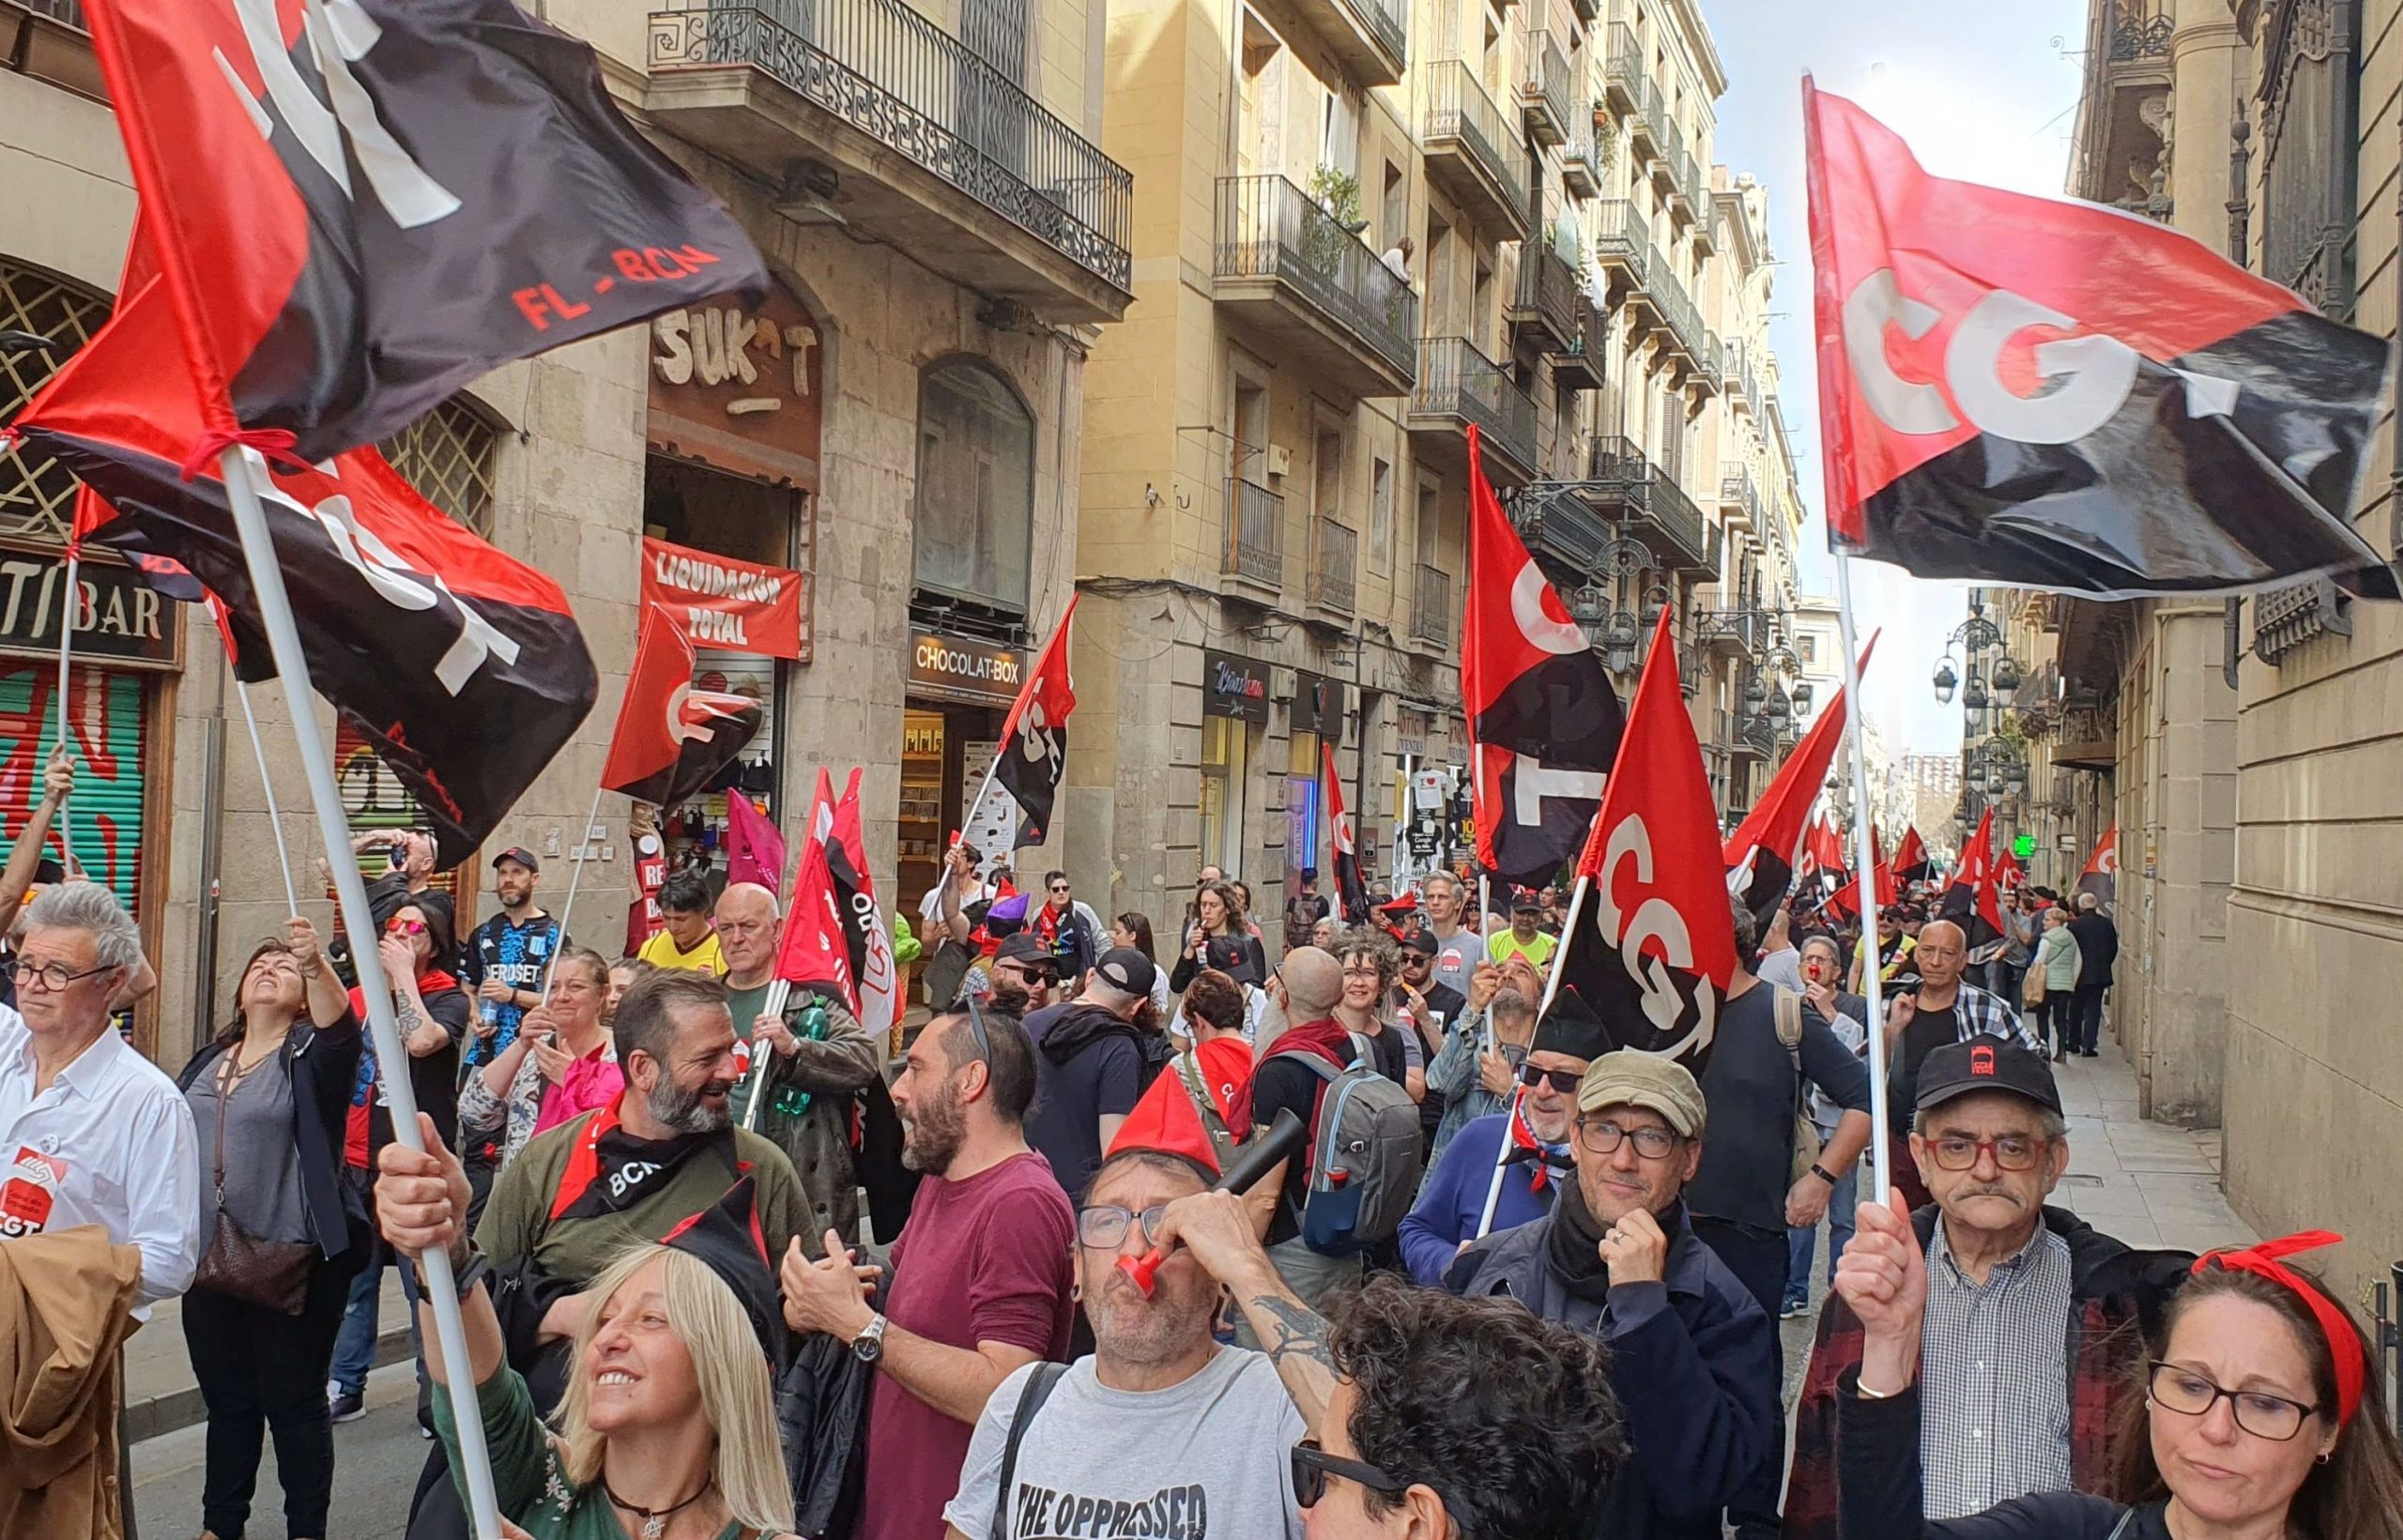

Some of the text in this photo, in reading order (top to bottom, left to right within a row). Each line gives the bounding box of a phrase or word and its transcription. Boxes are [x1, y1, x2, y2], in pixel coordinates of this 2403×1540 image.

[511, 282, 592, 331] FL
[612, 243, 722, 282] BCN
[1842, 267, 2241, 444] CG
[656, 551, 782, 605] LIQUIDACIÓN
[71, 580, 162, 640] BAR
[688, 606, 748, 646] TOTAL
[915, 645, 1019, 685] CHOCOLAT-BOX
[1442, 965, 1461, 973] CGT
[1018, 1483, 1057, 1538] THE
